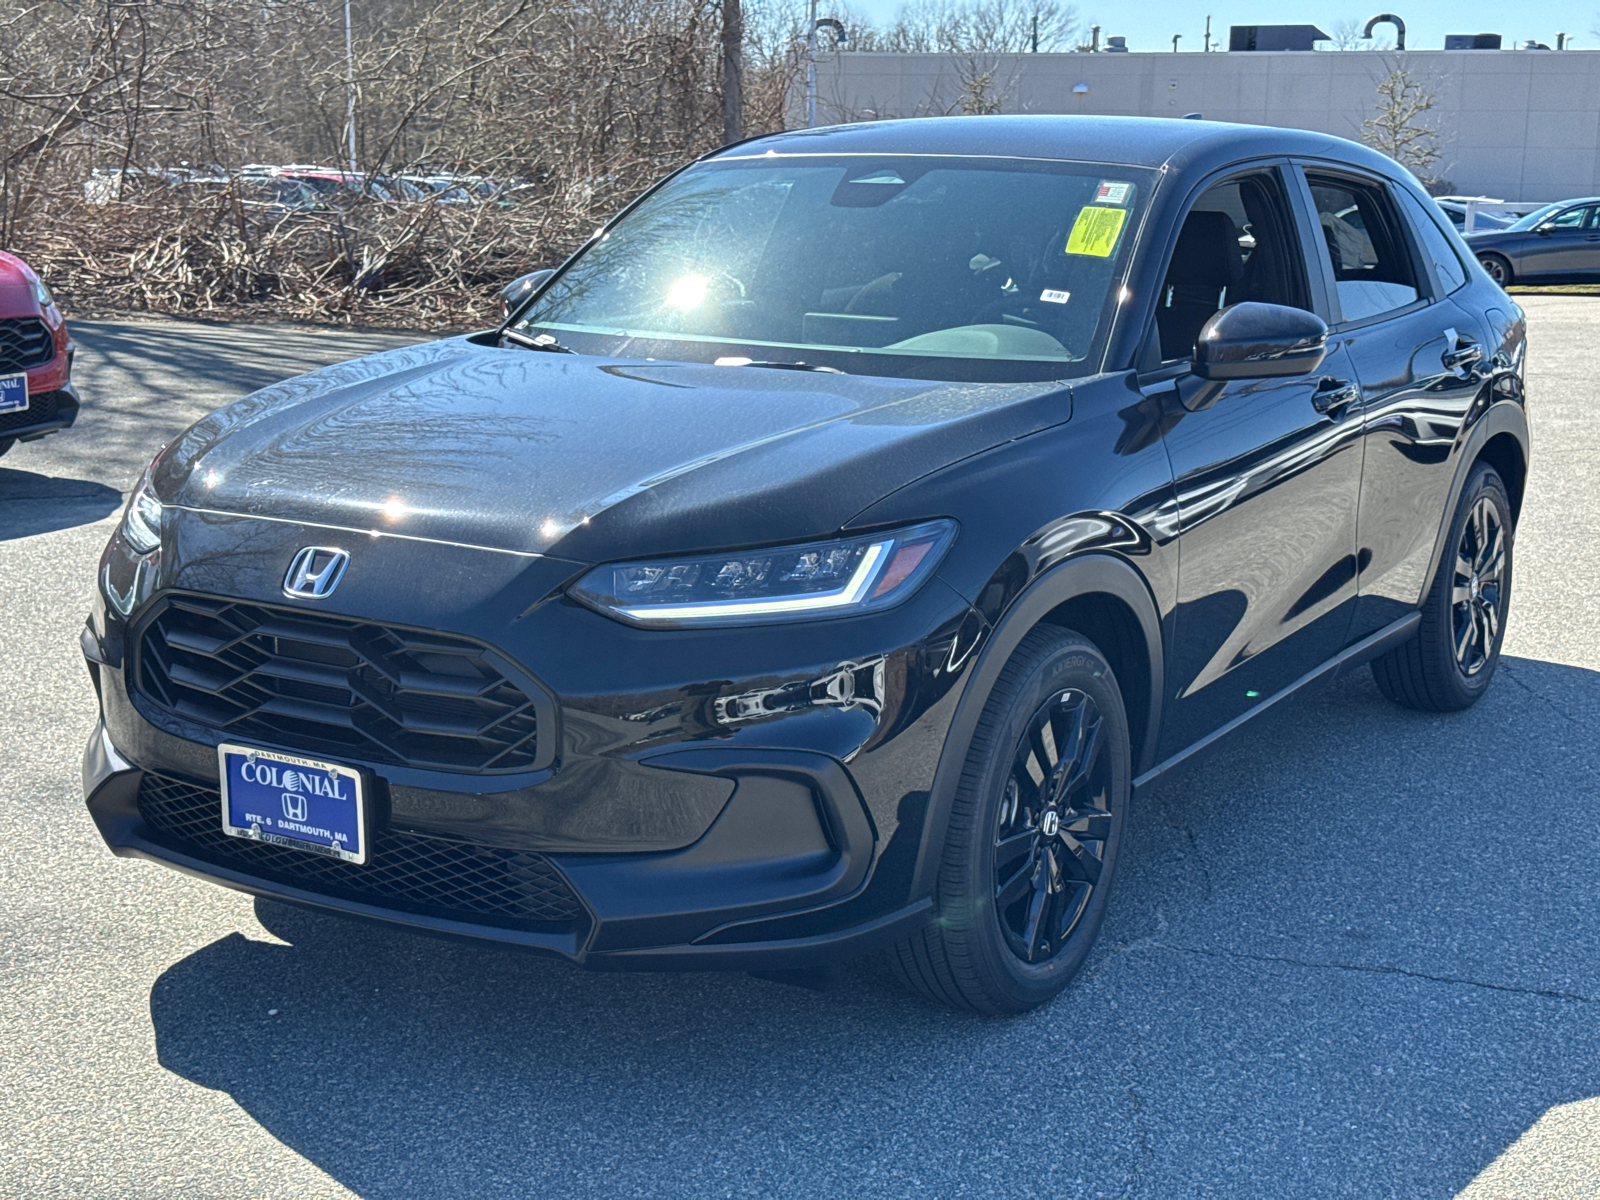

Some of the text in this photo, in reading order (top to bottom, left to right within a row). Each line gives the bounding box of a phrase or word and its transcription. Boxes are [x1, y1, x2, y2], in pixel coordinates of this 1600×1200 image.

[313, 761, 328, 770] MA
[240, 761, 347, 800] COLONIAL
[245, 813, 349, 842] RTE. 6 DARTMOUTH, MA
